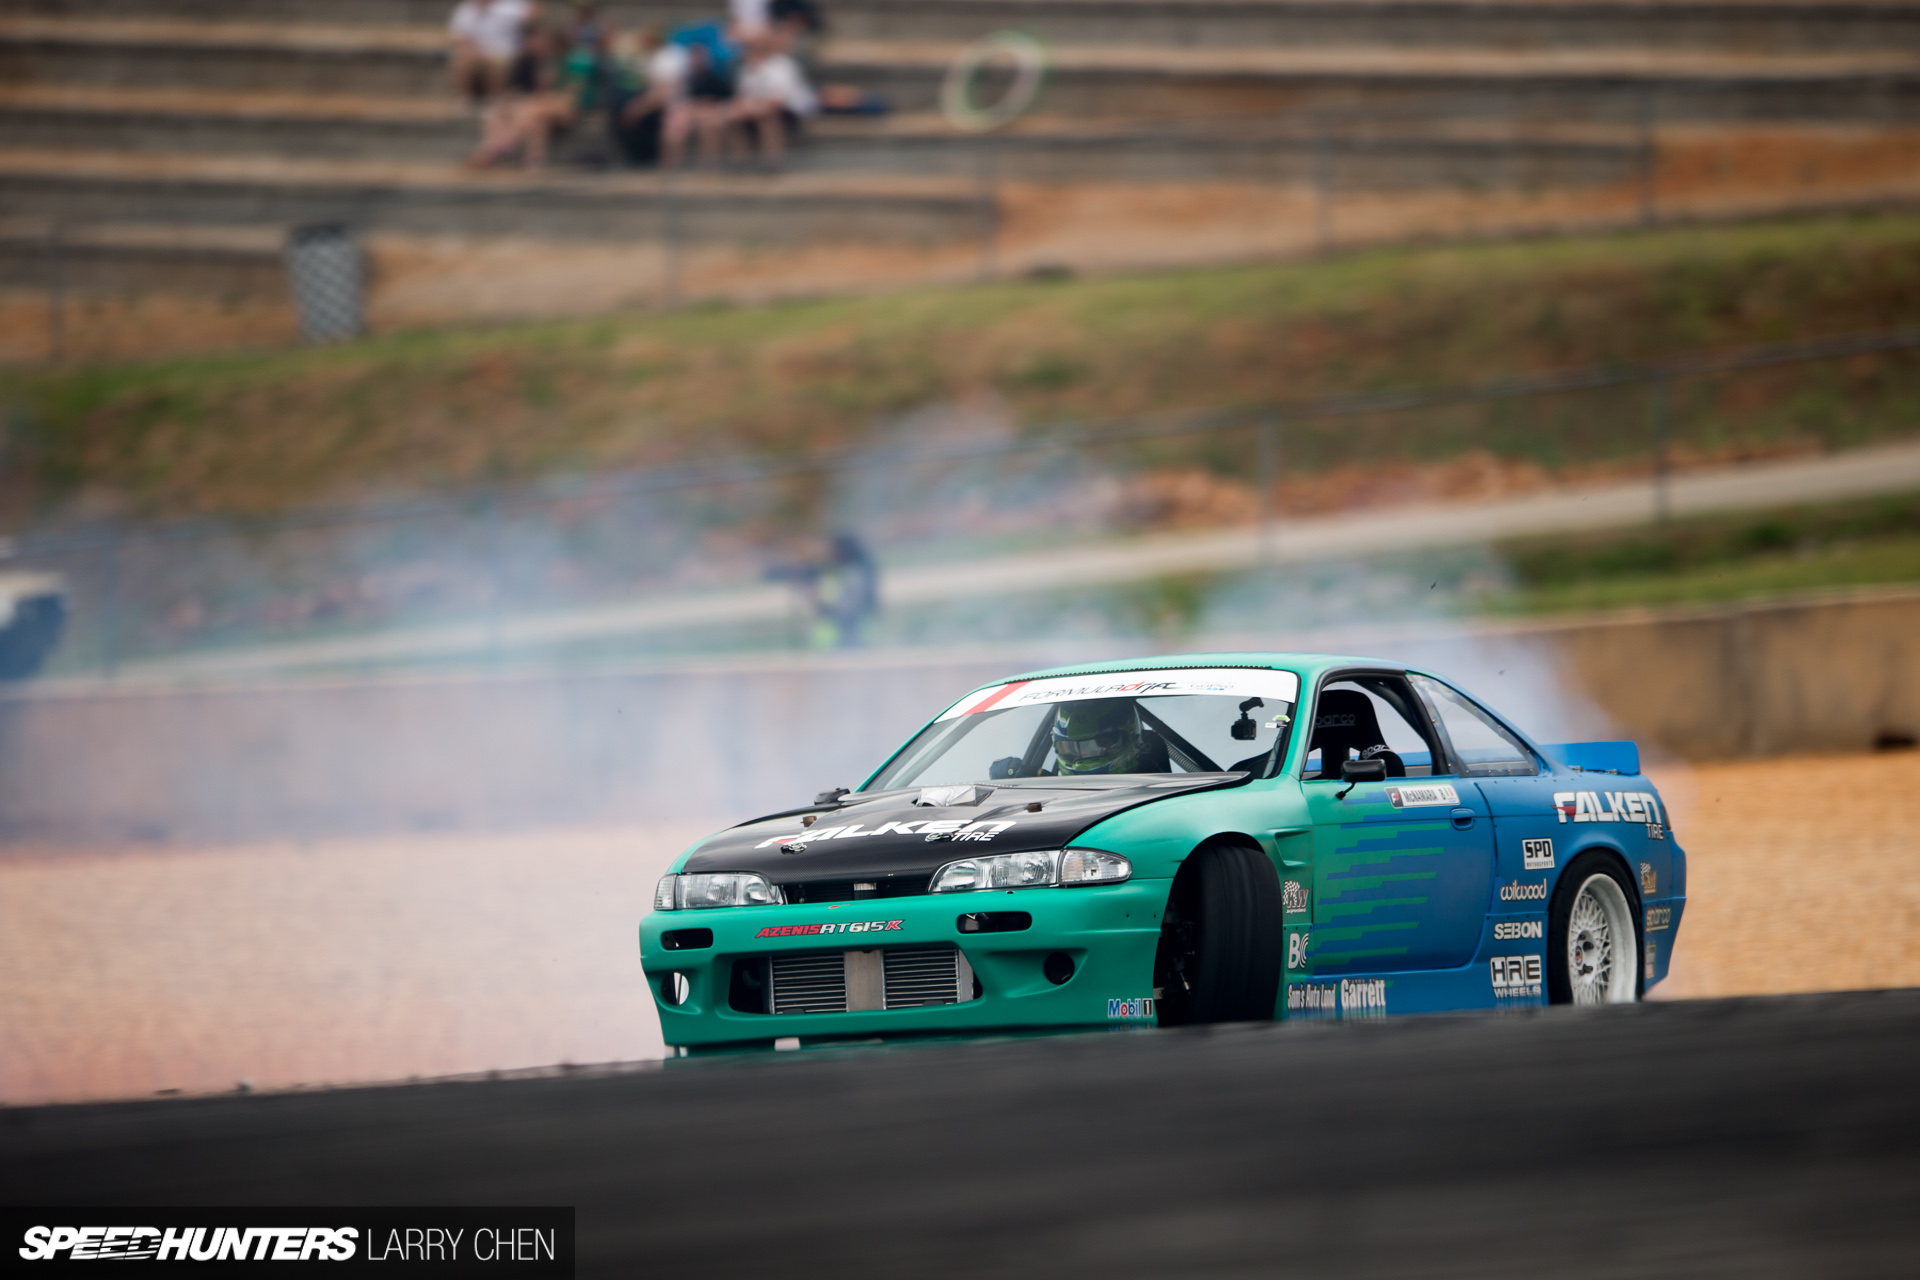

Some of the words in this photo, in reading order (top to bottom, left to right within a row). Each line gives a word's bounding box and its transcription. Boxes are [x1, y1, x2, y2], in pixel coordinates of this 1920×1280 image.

[1552, 791, 1661, 824] FALKEN
[754, 820, 1017, 849] FALKEN
[951, 831, 1000, 842] TIRE
[1646, 823, 1664, 840] TIRE
[1525, 840, 1552, 859] SPD
[1500, 878, 1547, 901] wilwood
[1490, 954, 1542, 987] HRE
[1341, 978, 1386, 1010] Garrett
[1494, 987, 1541, 998] WHEELS
[1108, 998, 1142, 1019] Mobil
